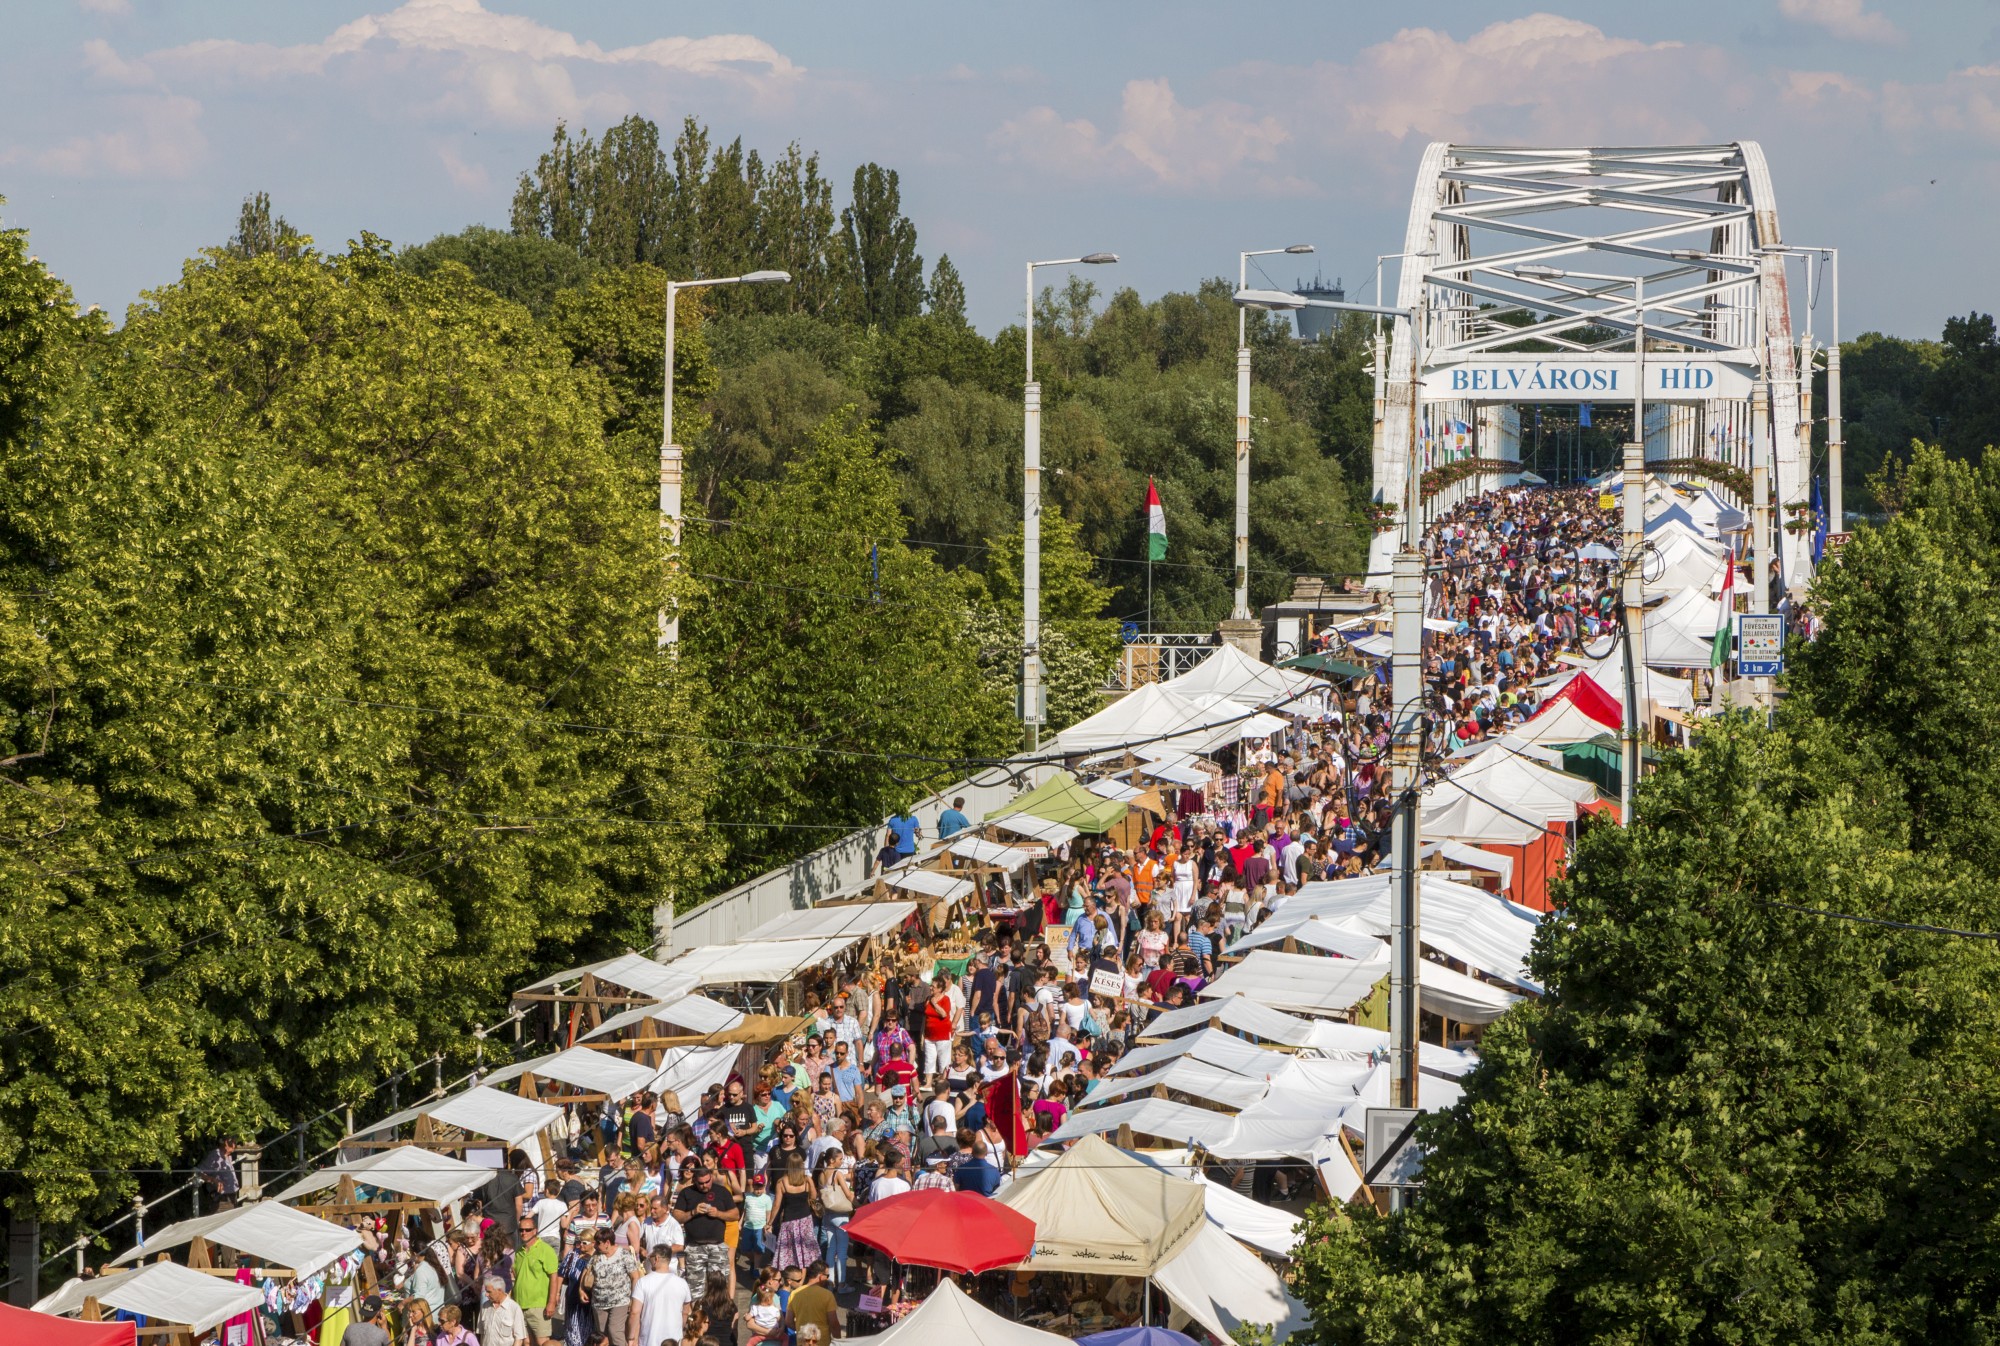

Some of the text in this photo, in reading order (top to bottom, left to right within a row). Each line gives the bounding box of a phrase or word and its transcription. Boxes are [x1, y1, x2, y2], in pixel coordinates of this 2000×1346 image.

[1452, 362, 1714, 390] BELVÁROSI HÍD
[1744, 664, 1763, 672] 3 km
